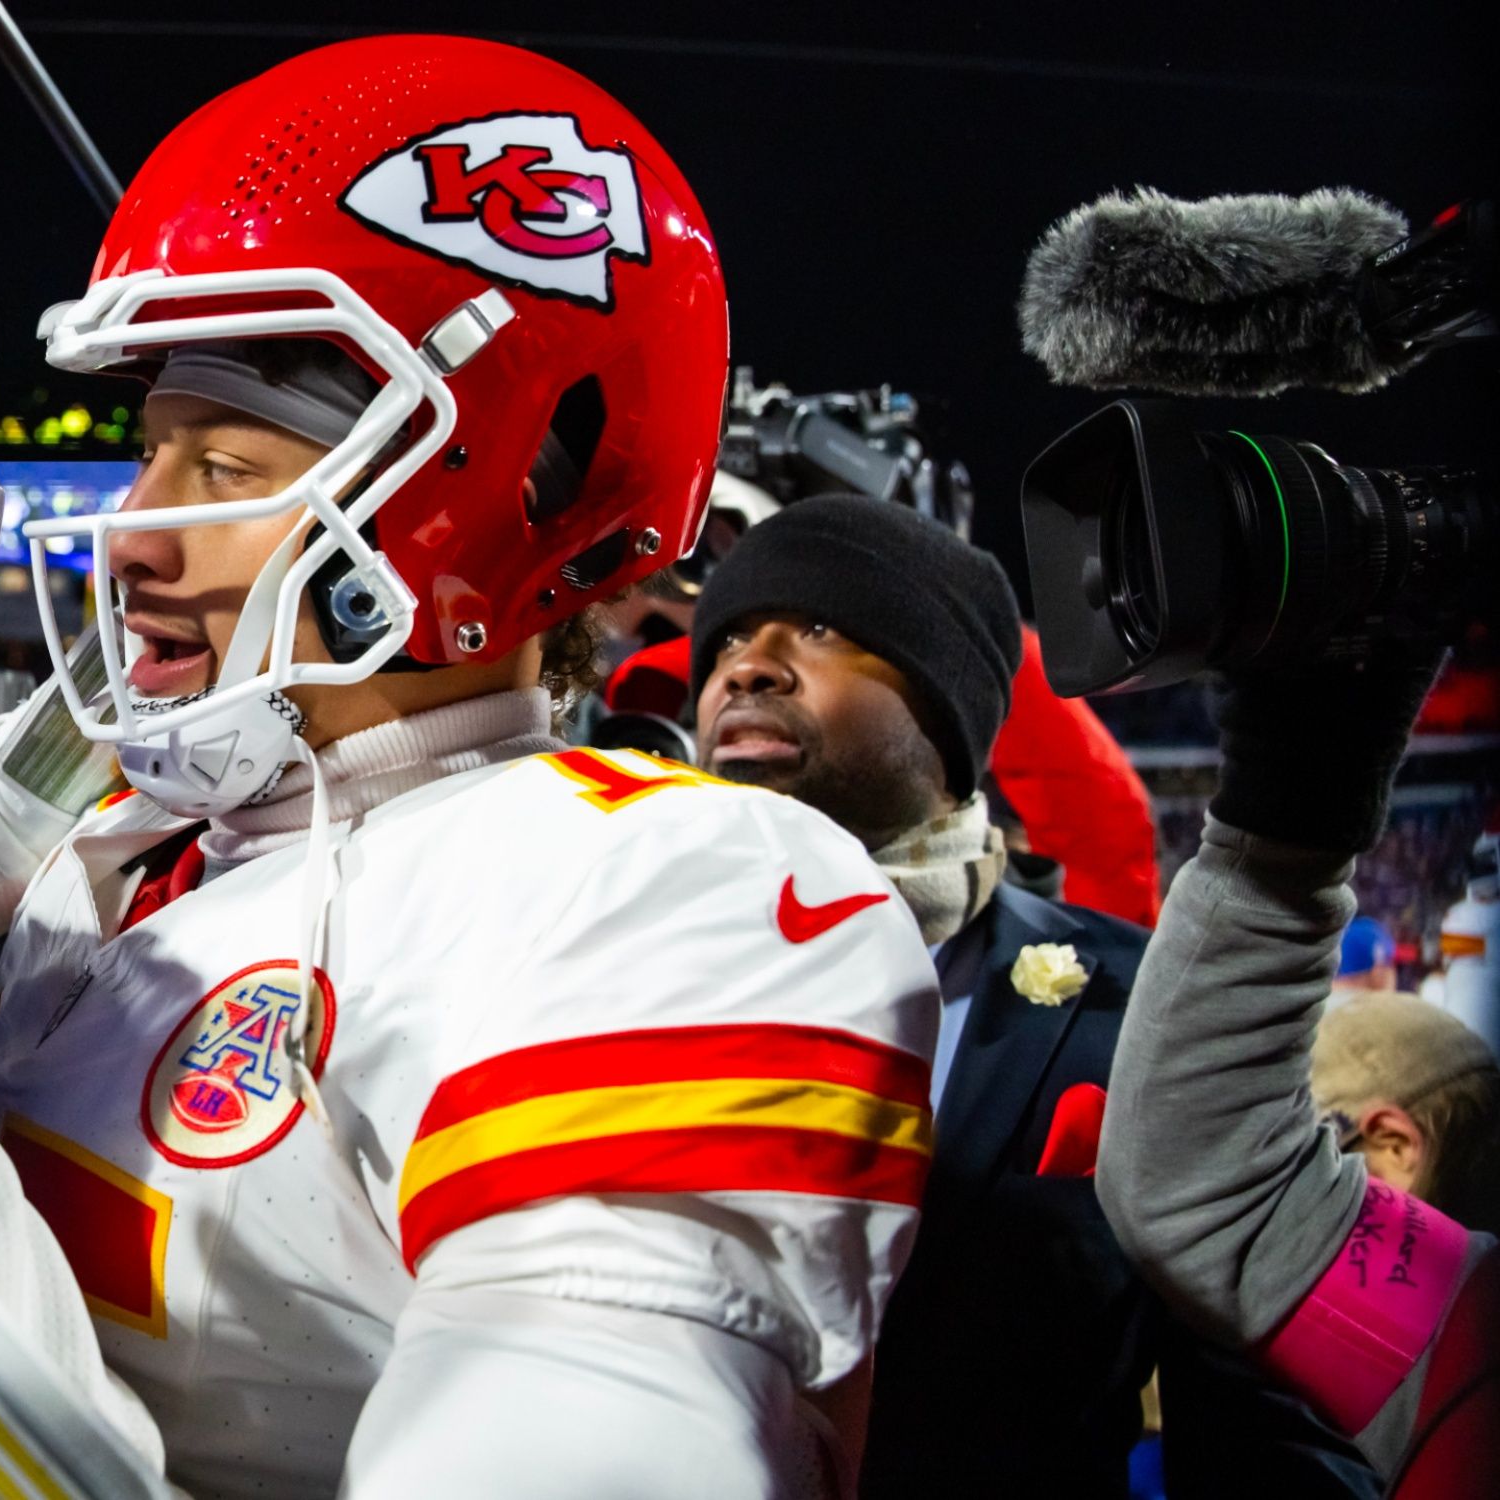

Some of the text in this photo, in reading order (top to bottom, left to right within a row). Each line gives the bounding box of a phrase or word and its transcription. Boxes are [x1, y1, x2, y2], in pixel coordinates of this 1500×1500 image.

[412, 143, 615, 260] KC
[1375, 239, 1410, 267] SONY
[188, 1082, 227, 1117] LH
